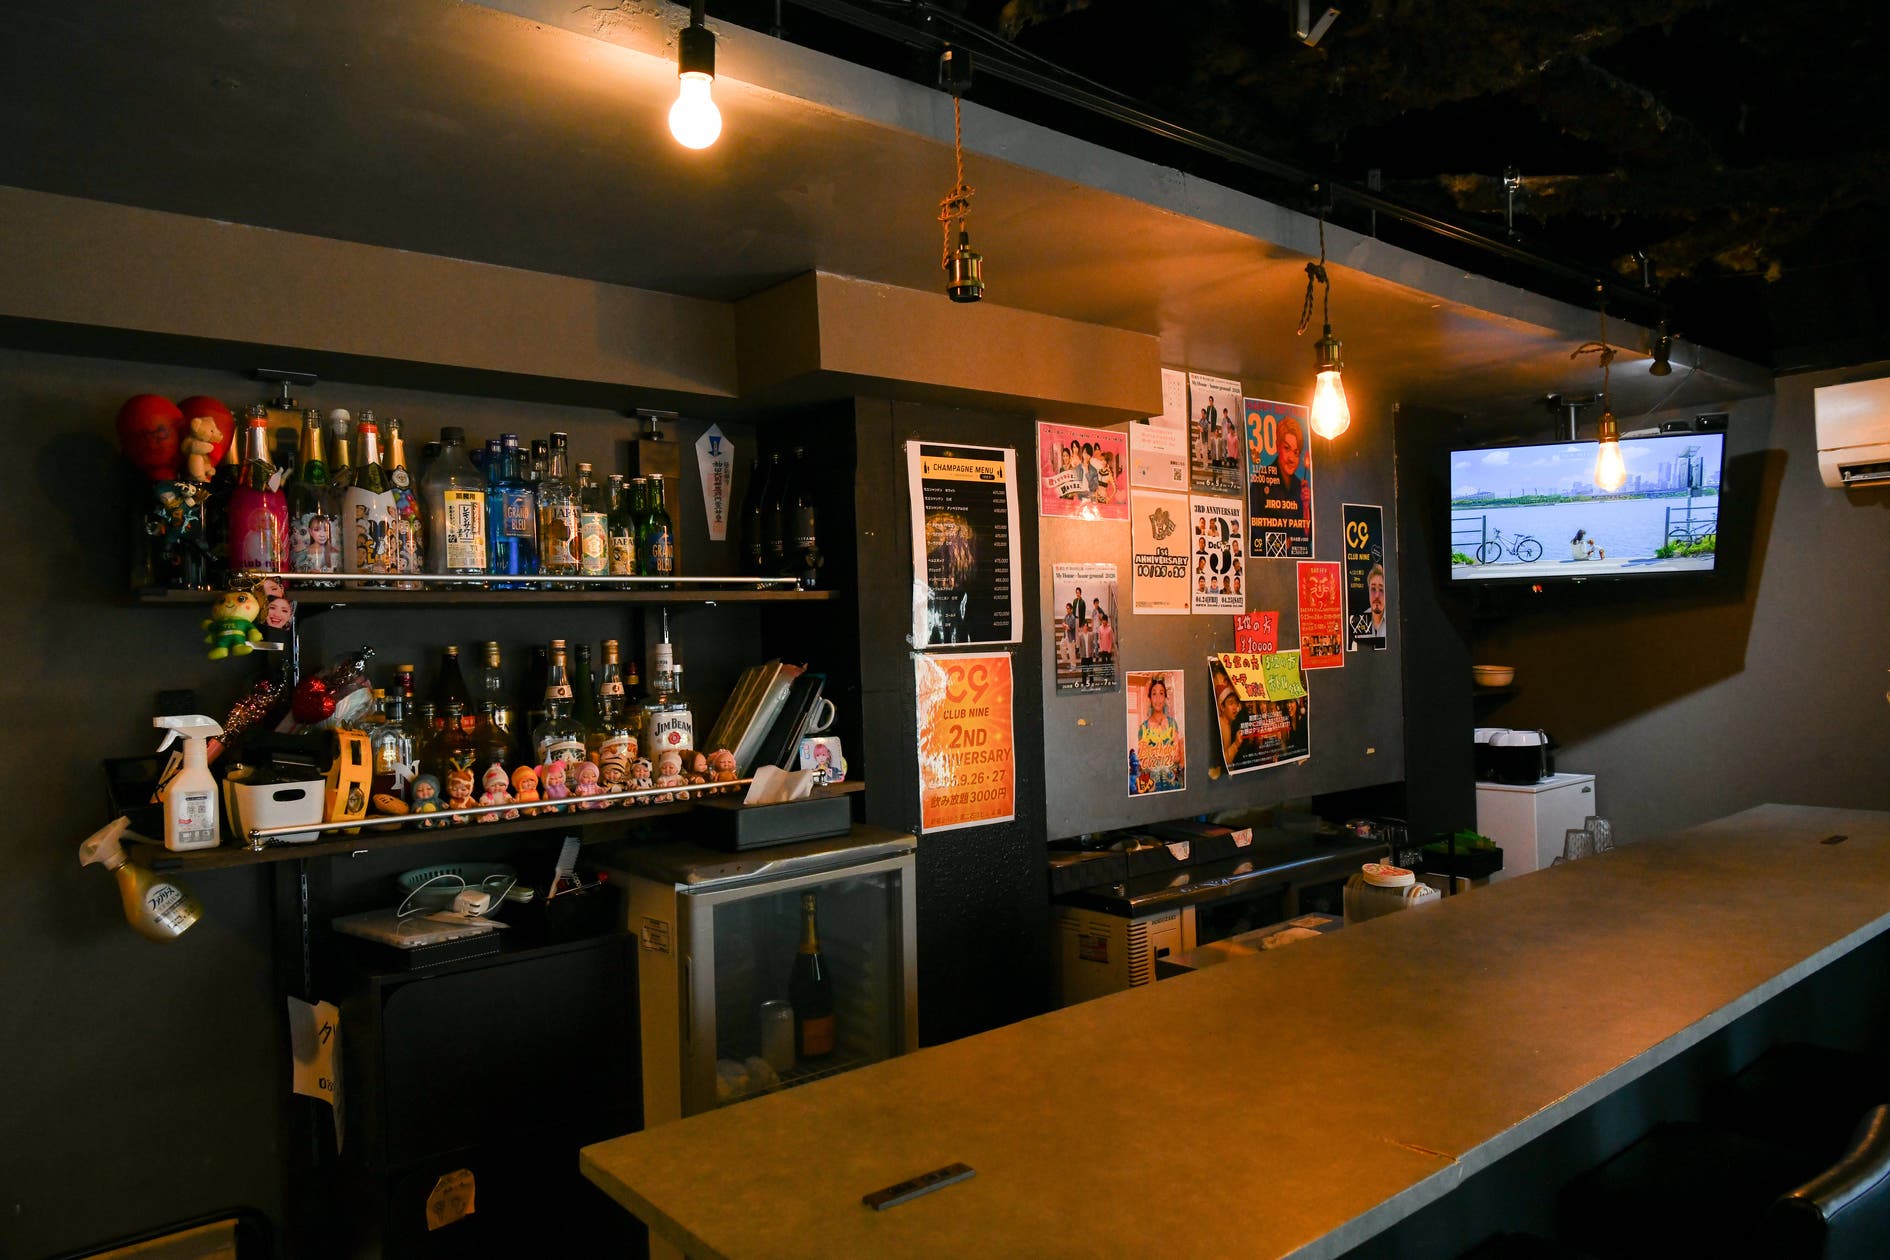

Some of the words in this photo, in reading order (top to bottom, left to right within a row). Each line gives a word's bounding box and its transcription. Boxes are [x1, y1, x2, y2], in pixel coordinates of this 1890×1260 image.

[1248, 413, 1277, 456] 30
[933, 463, 973, 473] CHAMPAGNE
[975, 466, 994, 474] MENU
[1267, 466, 1278, 475] FRI
[1266, 477, 1281, 486] open
[1194, 504, 1206, 514] 3RD
[1206, 506, 1241, 517] ANNIVERSARY
[1264, 499, 1282, 509] JIRO
[1282, 500, 1298, 510] 30th
[507, 507, 529, 519] GRAND
[511, 520, 526, 531] BLEU
[1251, 517, 1288, 528] BIRTHDAY
[1288, 519, 1311, 529] PARTY
[1346, 521, 1370, 549] C9
[1135, 554, 1188, 566] ANNIVERSARY
[1347, 553, 1358, 561] CLUB
[657, 558, 673, 572] BLEU
[945, 664, 989, 704] C9
[943, 708, 967, 720] CLUB
[968, 707, 990, 719] NINE
[655, 722, 672, 737] JIM
[671, 718, 692, 734] BEAM
[949, 724, 988, 749] 2ND
[930, 747, 1012, 768] NIVERSARY
[930, 787, 1007, 808] 飲み放題3000円
